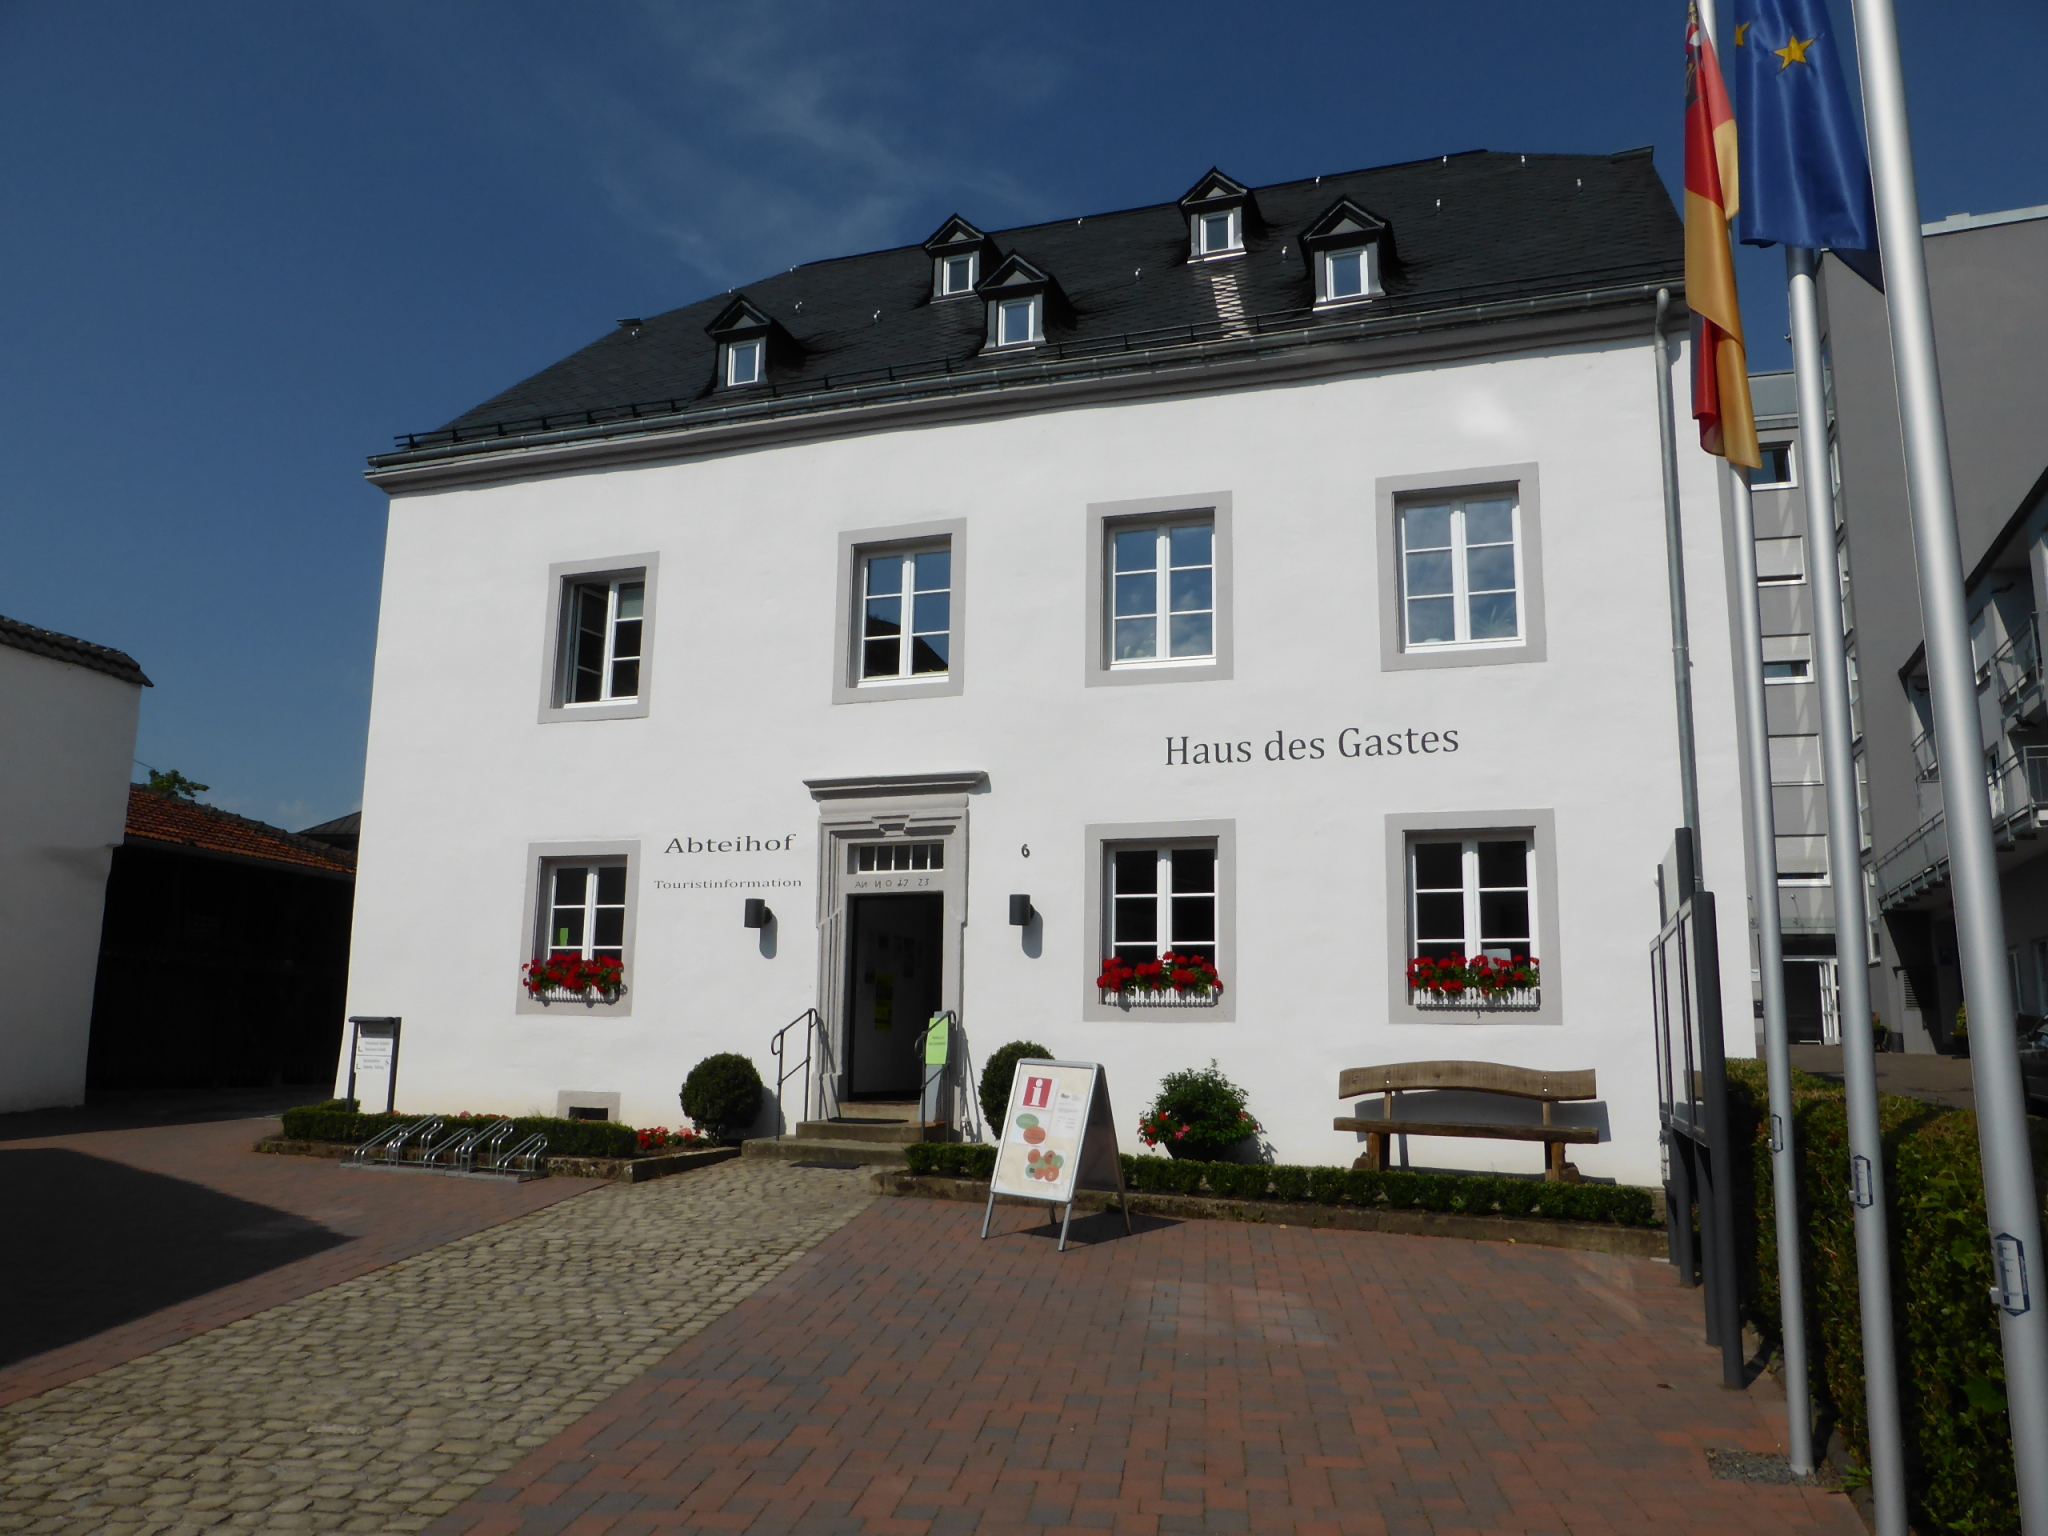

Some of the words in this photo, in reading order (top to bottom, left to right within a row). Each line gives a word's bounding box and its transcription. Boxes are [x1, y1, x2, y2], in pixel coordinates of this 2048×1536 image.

[1164, 735, 1252, 766] Haus
[1264, 730, 1325, 761] des
[1338, 726, 1459, 758] Gastes
[664, 833, 797, 854] Abteihof
[1021, 843, 1031, 858] 6
[653, 877, 802, 890] Touristinformation
